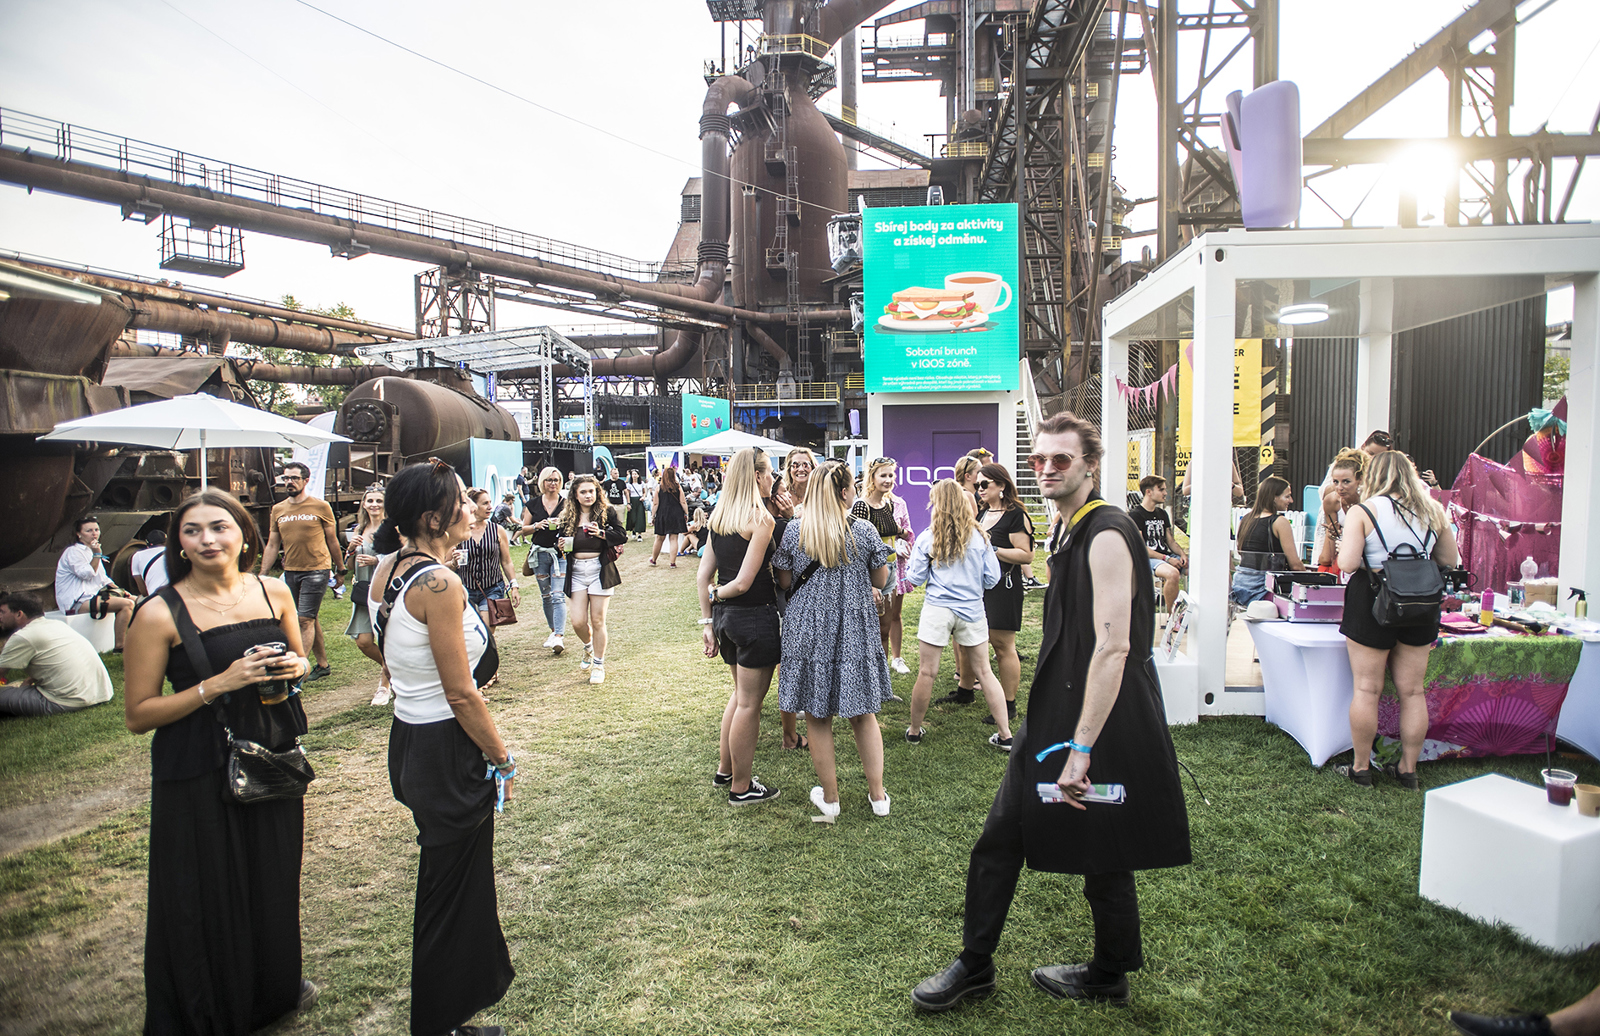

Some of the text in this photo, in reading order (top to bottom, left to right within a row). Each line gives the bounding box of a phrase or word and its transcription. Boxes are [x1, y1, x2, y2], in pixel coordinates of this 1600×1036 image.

[875, 218, 1003, 234] Sbírej body za aktivity
[894, 233, 987, 248] a získej odměnu.
[906, 346, 977, 356] Sobotní brunch
[919, 359, 945, 368] IQOS
[947, 358, 972, 368] zóně.
[373, 379, 385, 401] 1
[298, 513, 318, 521] Klein
